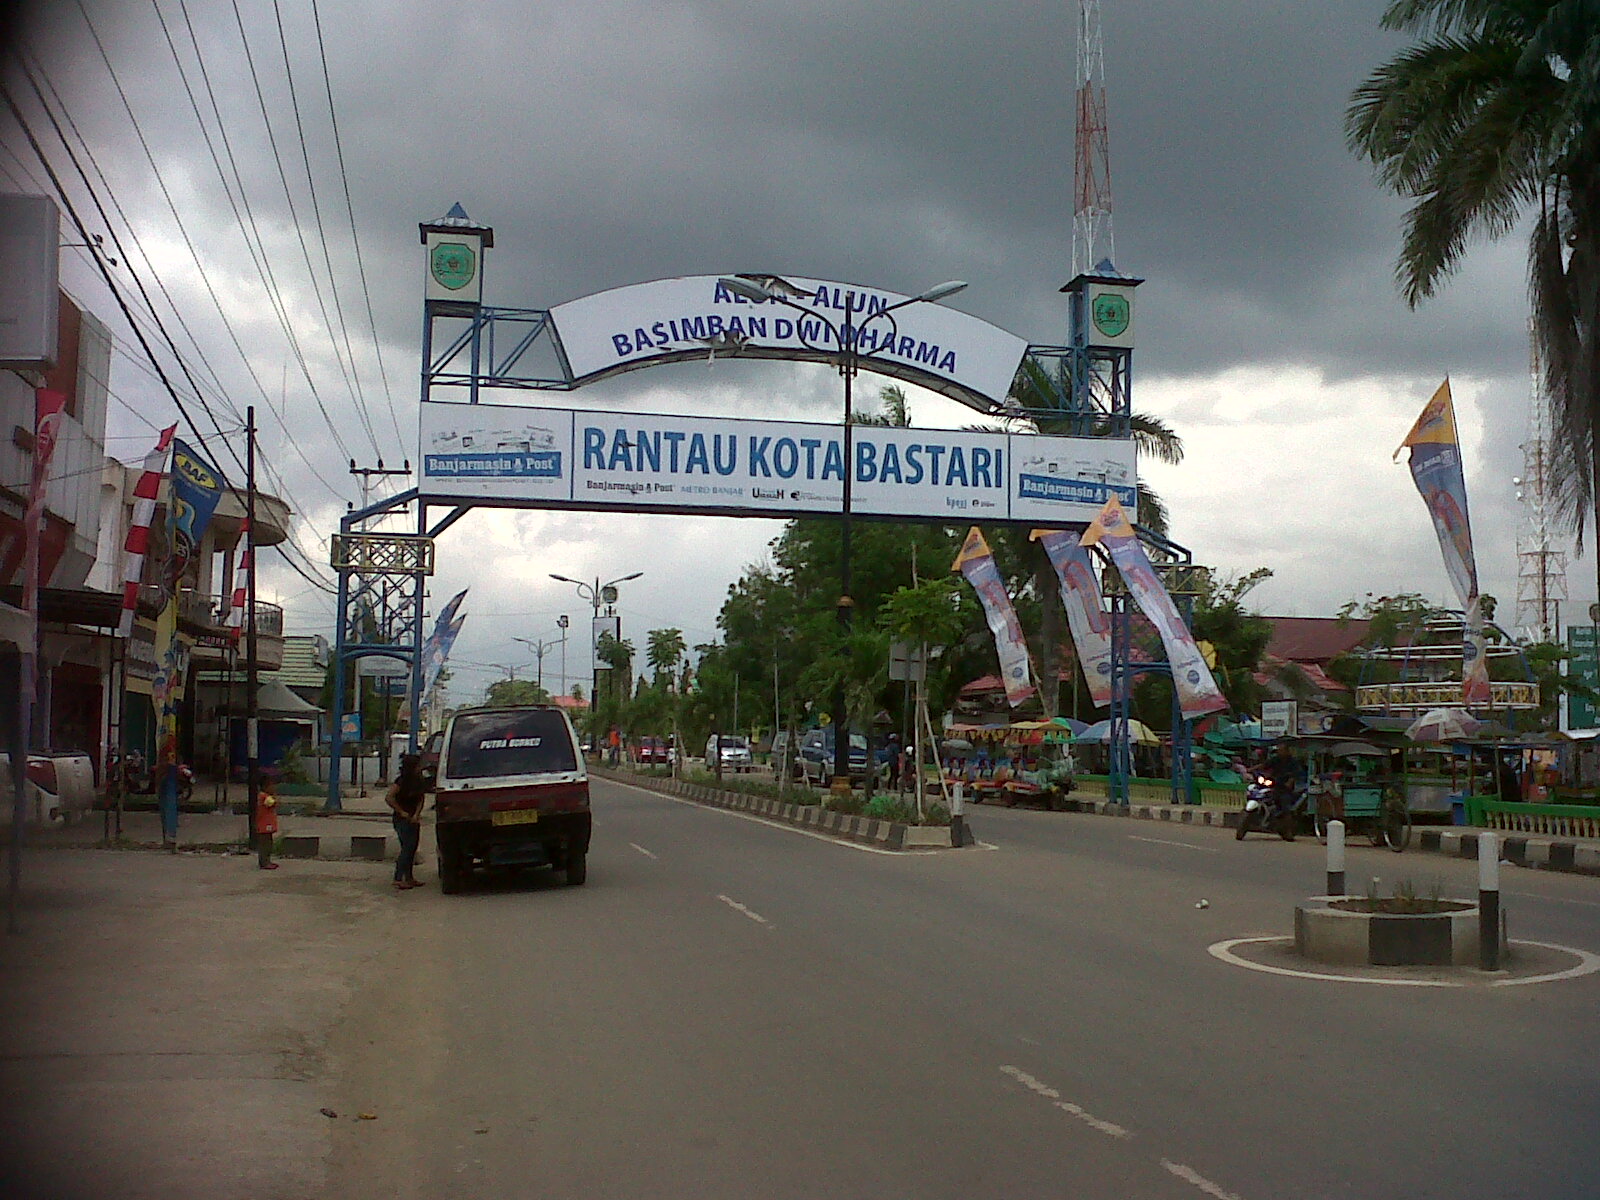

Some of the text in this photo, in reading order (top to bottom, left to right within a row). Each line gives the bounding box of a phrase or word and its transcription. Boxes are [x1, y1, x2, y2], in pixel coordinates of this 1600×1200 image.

[714, 282, 788, 304] AL
[813, 285, 887, 318] ALUN
[612, 315, 957, 373] BASIMBAN DWI DHARMA
[428, 457, 555, 473] Banjarmasin Post
[584, 427, 1003, 488] RANTAU KOTA BASTARI
[1023, 479, 1129, 502] Banjarmasin Pst
